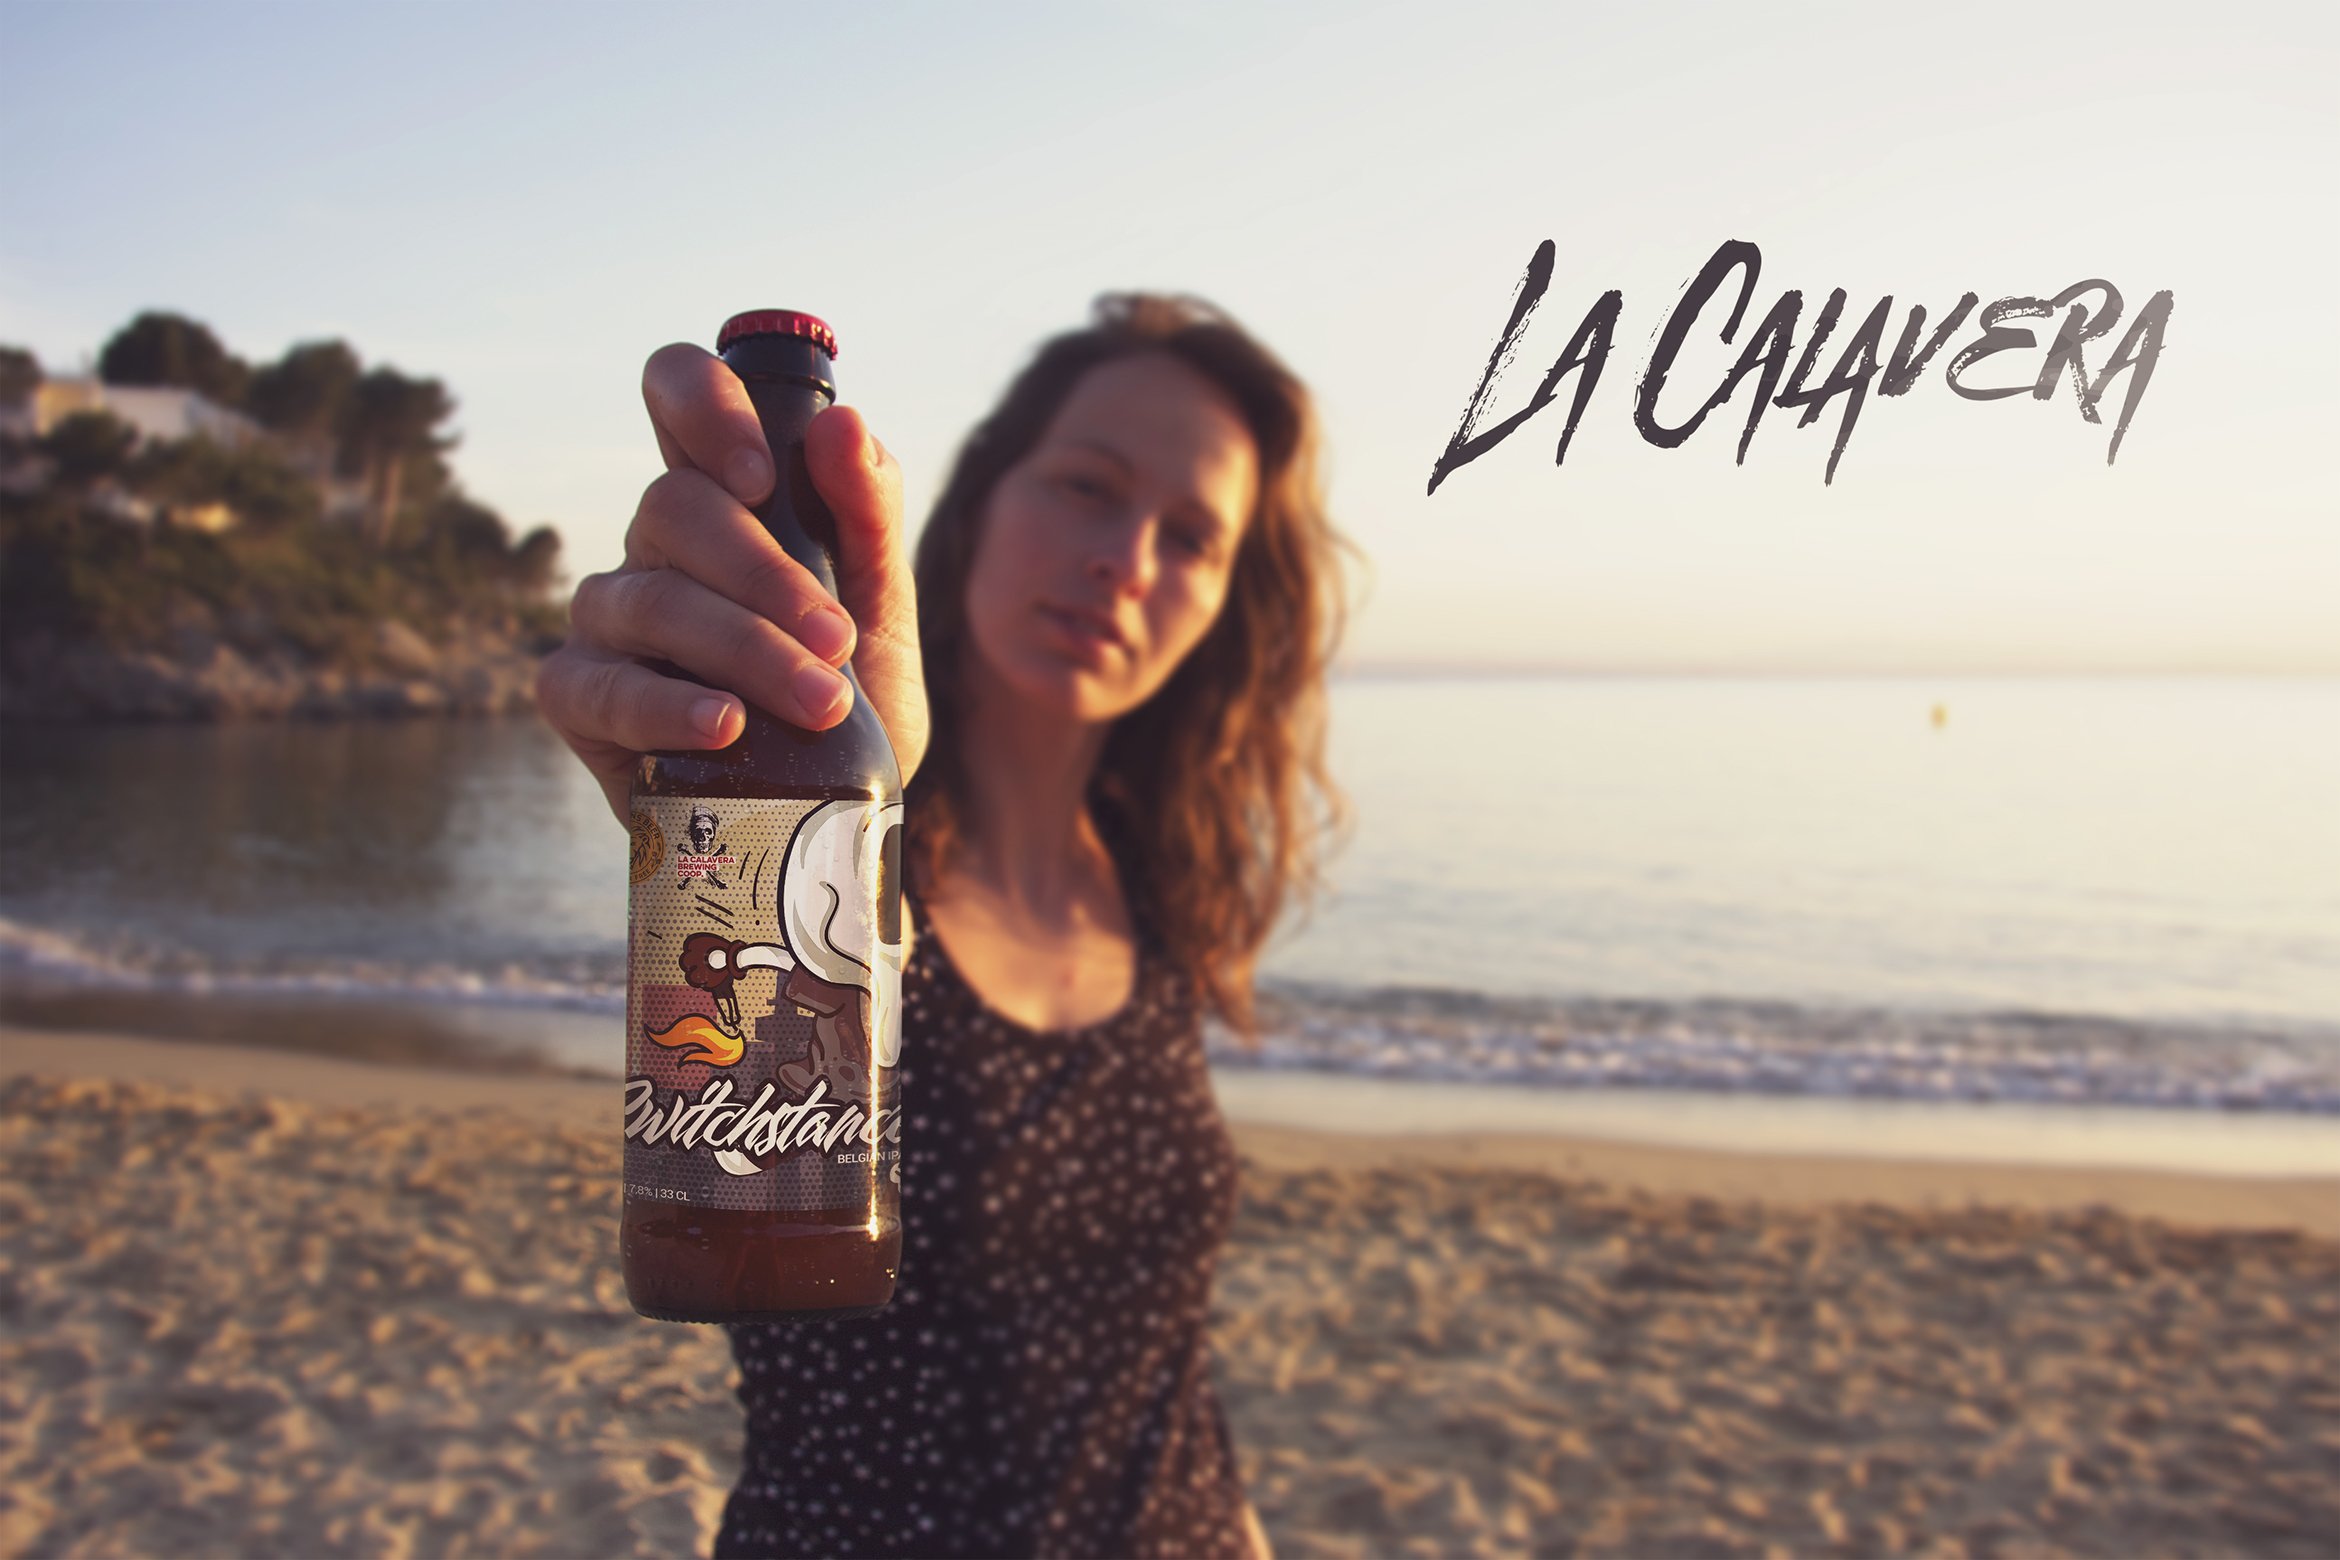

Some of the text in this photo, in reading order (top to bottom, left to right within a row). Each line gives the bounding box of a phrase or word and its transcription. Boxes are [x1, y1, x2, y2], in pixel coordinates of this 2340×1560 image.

[642, 818, 660, 840] BEER
[690, 856, 735, 864] CALAVERA
[677, 863, 717, 871] BREWING
[677, 870, 704, 878] COOP.
[660, 1188, 674, 1199] 33
[676, 1190, 691, 1202] CL
